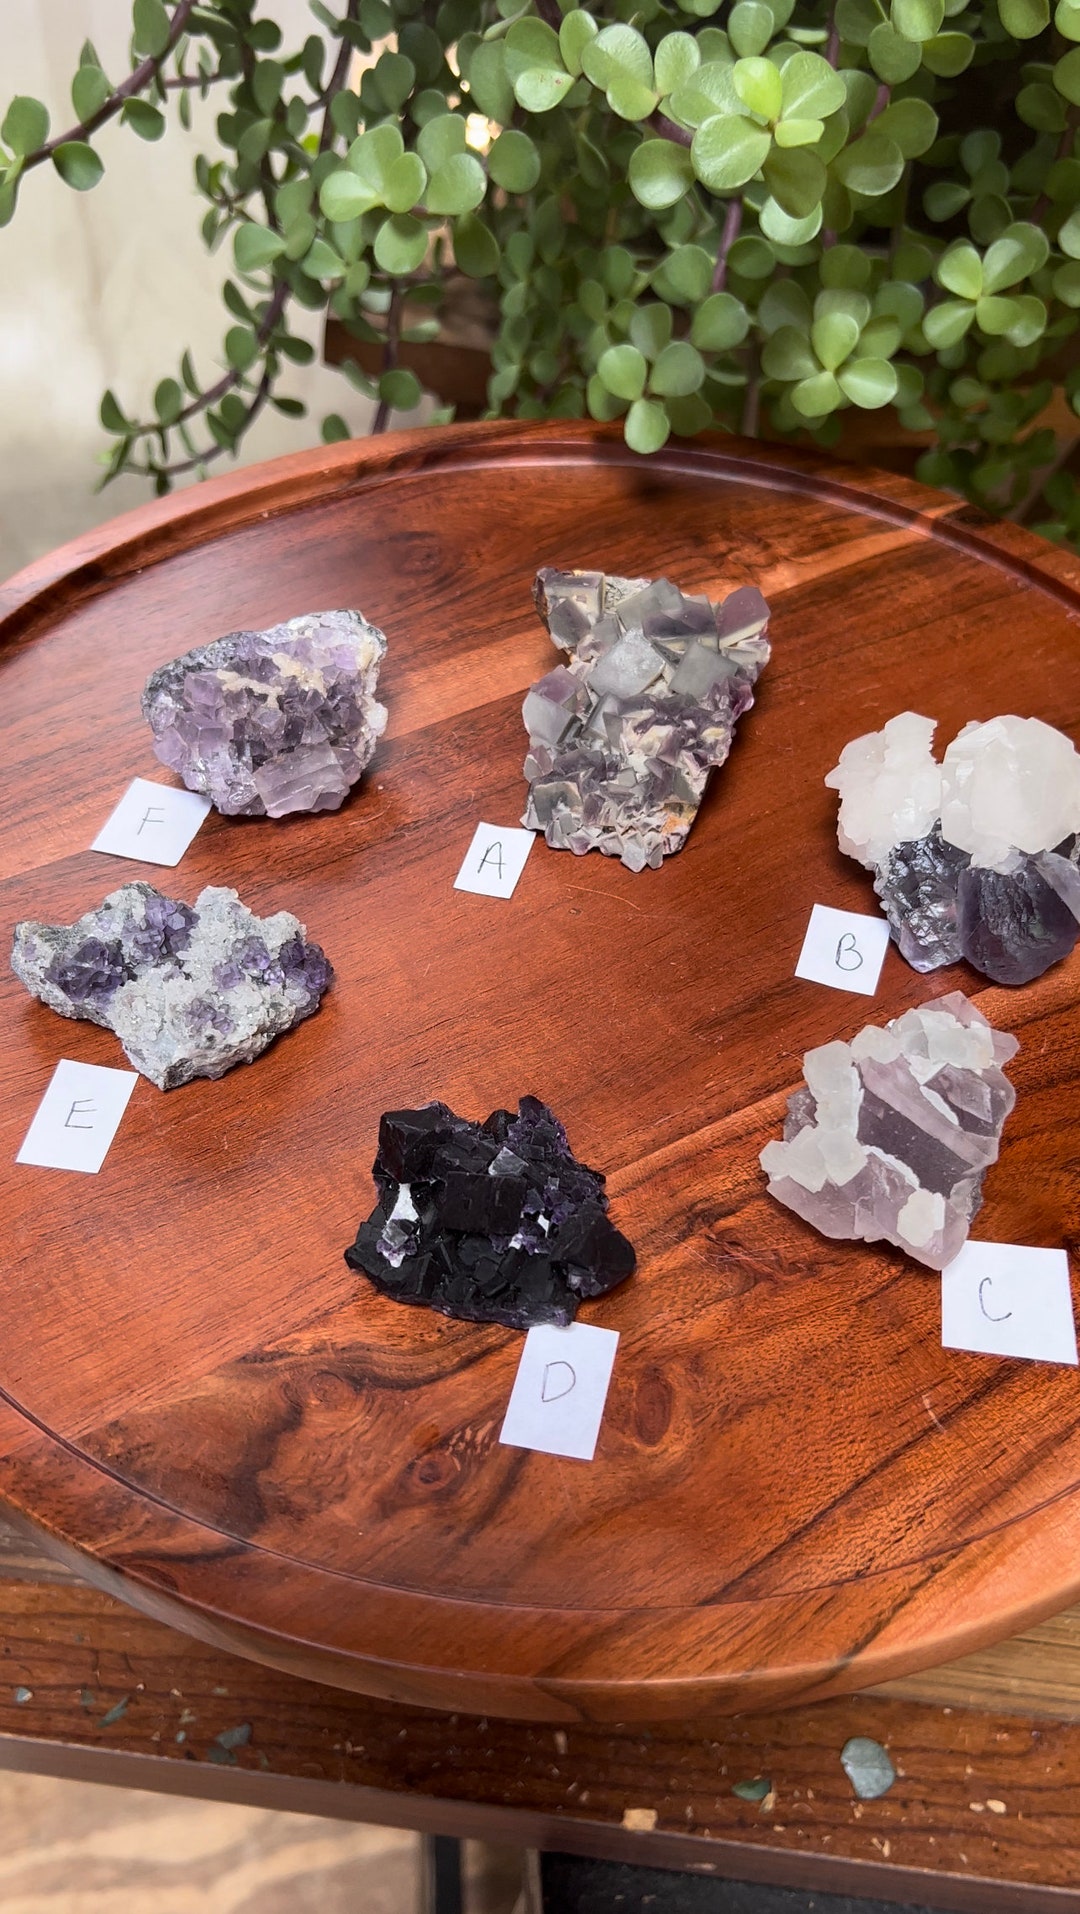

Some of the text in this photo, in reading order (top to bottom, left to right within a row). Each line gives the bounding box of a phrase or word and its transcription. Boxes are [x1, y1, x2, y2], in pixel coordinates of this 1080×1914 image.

[136, 807, 165, 836] F
[476, 841, 507, 880] A
[834, 932, 864, 972] B
[64, 1098, 97, 1130] E
[979, 1276, 1013, 1323] C
[541, 1360, 576, 1404] D
